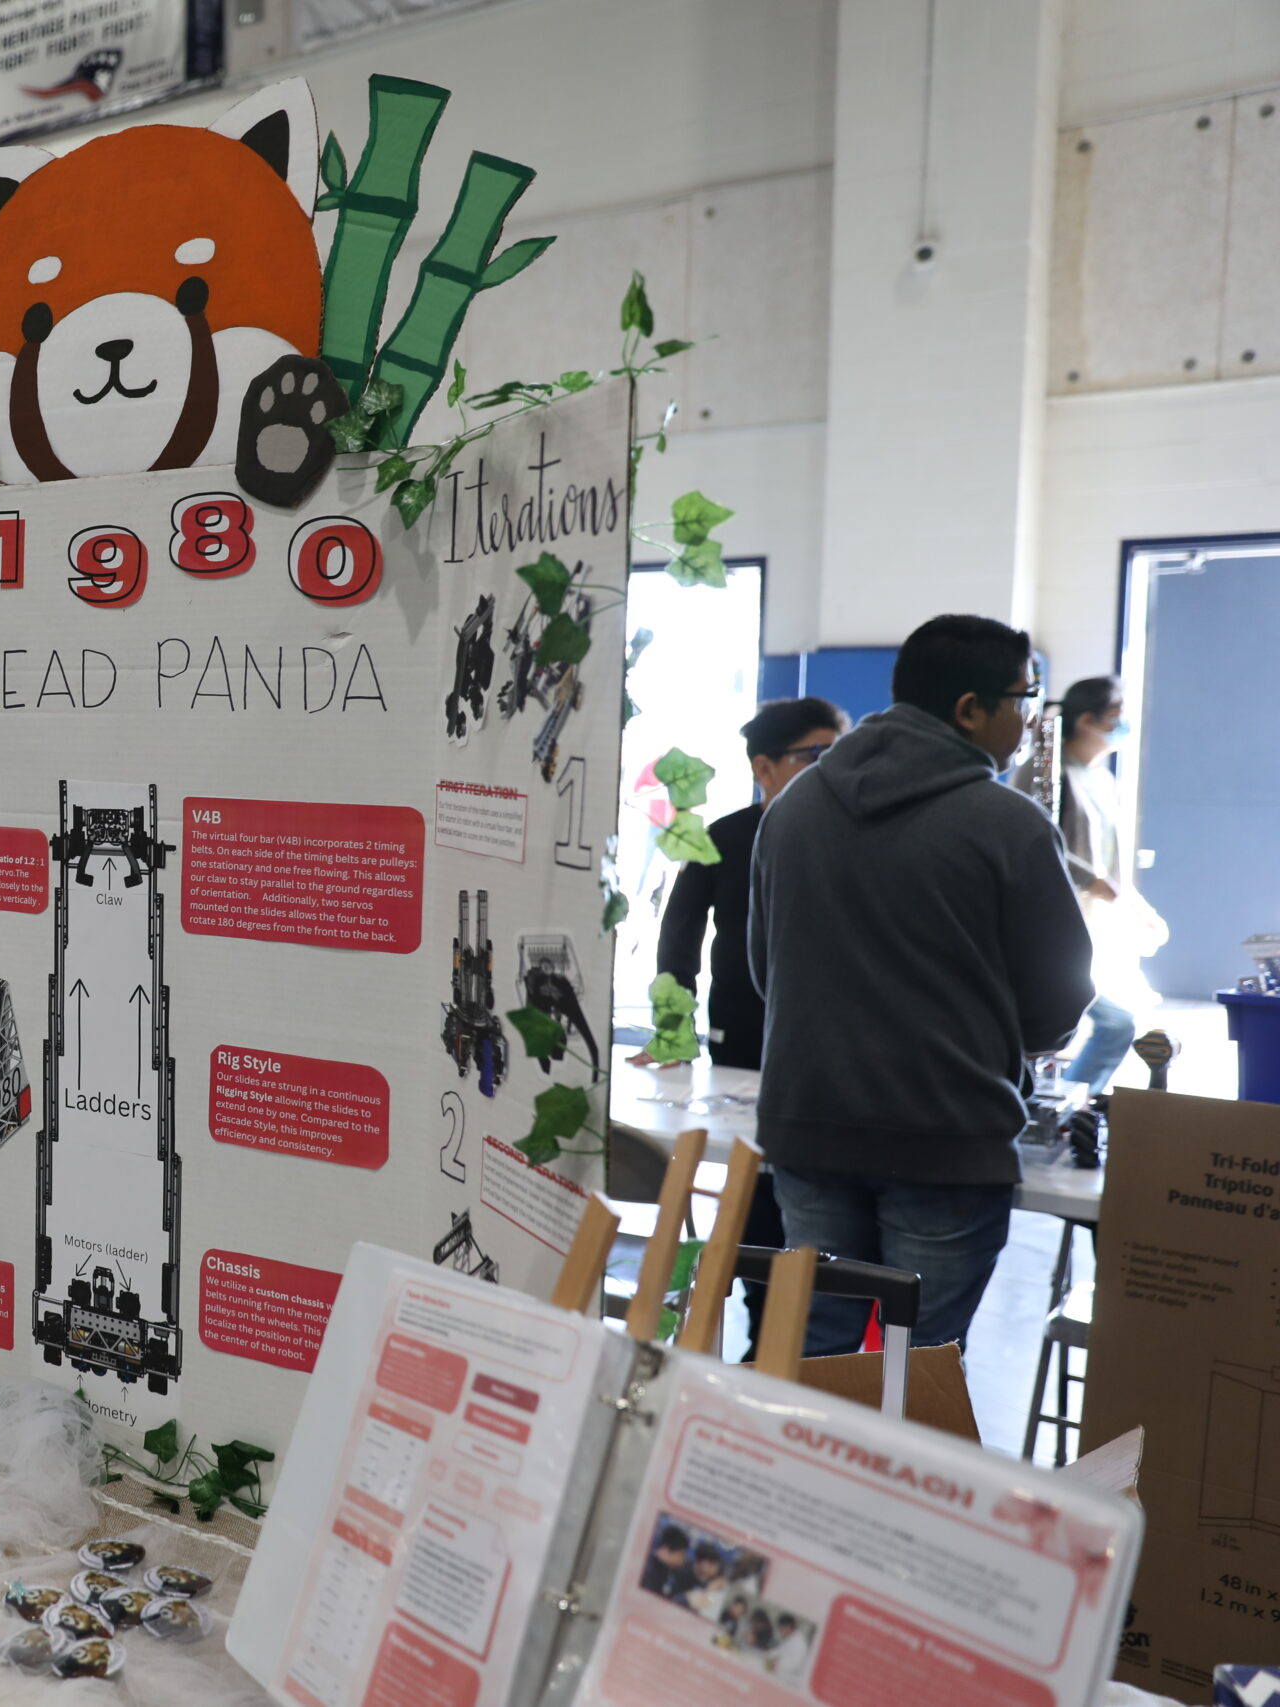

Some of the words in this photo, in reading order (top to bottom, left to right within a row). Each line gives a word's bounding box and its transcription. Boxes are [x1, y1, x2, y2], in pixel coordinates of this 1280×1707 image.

[444, 432, 625, 563] Iterations
[157, 635, 388, 714] PANDA
[192, 810, 221, 824] V4B
[191, 830, 208, 839] The
[209, 831, 237, 841] virtual
[239, 832, 258, 842] four
[259, 834, 275, 843] bar
[276, 835, 301, 846] (V4B)
[303, 836, 364, 849] incorporates
[365, 840, 372, 849] 2
[374, 841, 405, 854] timing
[191, 844, 215, 854] belts.
[216, 846, 230, 855] On
[231, 848, 252, 856] each
[254, 848, 273, 858] side
[274, 849, 285, 858] of
[286, 850, 302, 860] the
[303, 851, 333, 864] timing
[335, 853, 359, 864] belts
[361, 857, 377, 865] are
[379, 857, 417, 869] pulleys:
[190, 860, 207, 868] one
[208, 860, 253, 873] stationary
[254, 864, 272, 872] and
[273, 866, 291, 874] one
[292, 865, 312, 875] free
[313, 866, 350, 880] flowing.
[352, 869, 372, 879] This
[374, 871, 406, 882] allows
[190, 874, 205, 882] our
[206, 874, 227, 883] claw
[228, 876, 238, 884] to
[239, 877, 259, 888] stay
[260, 879, 294, 888] parallel
[296, 881, 306, 889] to
[308, 881, 324, 891] the
[325, 884, 360, 894] ground
[362, 887, 413, 897] regardless
[190, 886, 200, 895] of
[200, 888, 251, 899] orientation.
[262, 892, 319, 907] Additionally,
[321, 898, 339, 907] two
[341, 900, 373, 910] servos
[96, 893, 123, 906] Claw
[189, 902, 229, 912] mounted
[243, 905, 259, 915] the
[260, 907, 287, 917] slides
[288, 909, 317, 920] allows
[319, 912, 335, 921] the
[336, 913, 357, 923] four
[359, 915, 376, 924] bar
[378, 918, 389, 926] to
[189, 916, 216, 925] rotate
[217, 917, 234, 927] 180
[236, 919, 271, 931] degrees
[272, 922, 295, 932] from
[296, 925, 312, 934] the
[314, 925, 338, 937] front
[339, 929, 350, 937] to
[352, 929, 369, 939] the
[371, 931, 396, 942] back.
[218, 1051, 240, 1070] Rig
[243, 1055, 281, 1074] Style
[216, 1071, 233, 1081] Our
[234, 1074, 260, 1086] slides
[261, 1080, 277, 1088] are
[278, 1082, 307, 1096] strung
[309, 1087, 318, 1095] in
[327, 1090, 381, 1104] continuous
[65, 1088, 151, 1121] Ladders
[216, 1085, 248, 1100] Rigging
[249, 1090, 273, 1102] Style
[274, 1095, 312, 1110] allowing
[314, 1101, 329, 1111] the
[331, 1104, 359, 1116] slides
[361, 1109, 371, 1117] to
[215, 1100, 245, 1111] extend
[247, 1106, 264, 1114] one
[265, 1107, 277, 1119] by
[279, 1111, 298, 1120] one.
[300, 1113, 349, 1129] Compared
[351, 1122, 362, 1131] to
[363, 1123, 380, 1134] the
[215, 1112, 252, 1126] Cascade
[253, 1119, 278, 1133] Style,
[280, 1124, 297, 1135] this
[299, 1127, 343, 1142] improves
[214, 1127, 257, 1144] efficiency
[258, 1136, 275, 1145] and
[277, 1139, 334, 1157] consistency.
[1168, 1189, 1247, 1215] Panneau
[64, 1234, 103, 1253] Motors
[105, 1244, 149, 1264] (ladder)
[206, 1256, 260, 1279] Chassis
[780, 1420, 977, 1511] OUTREACH
[1219, 1573, 1242, 1590] 48
[1246, 1581, 1261, 1596] in
[1229, 1600, 1247, 1614] m
